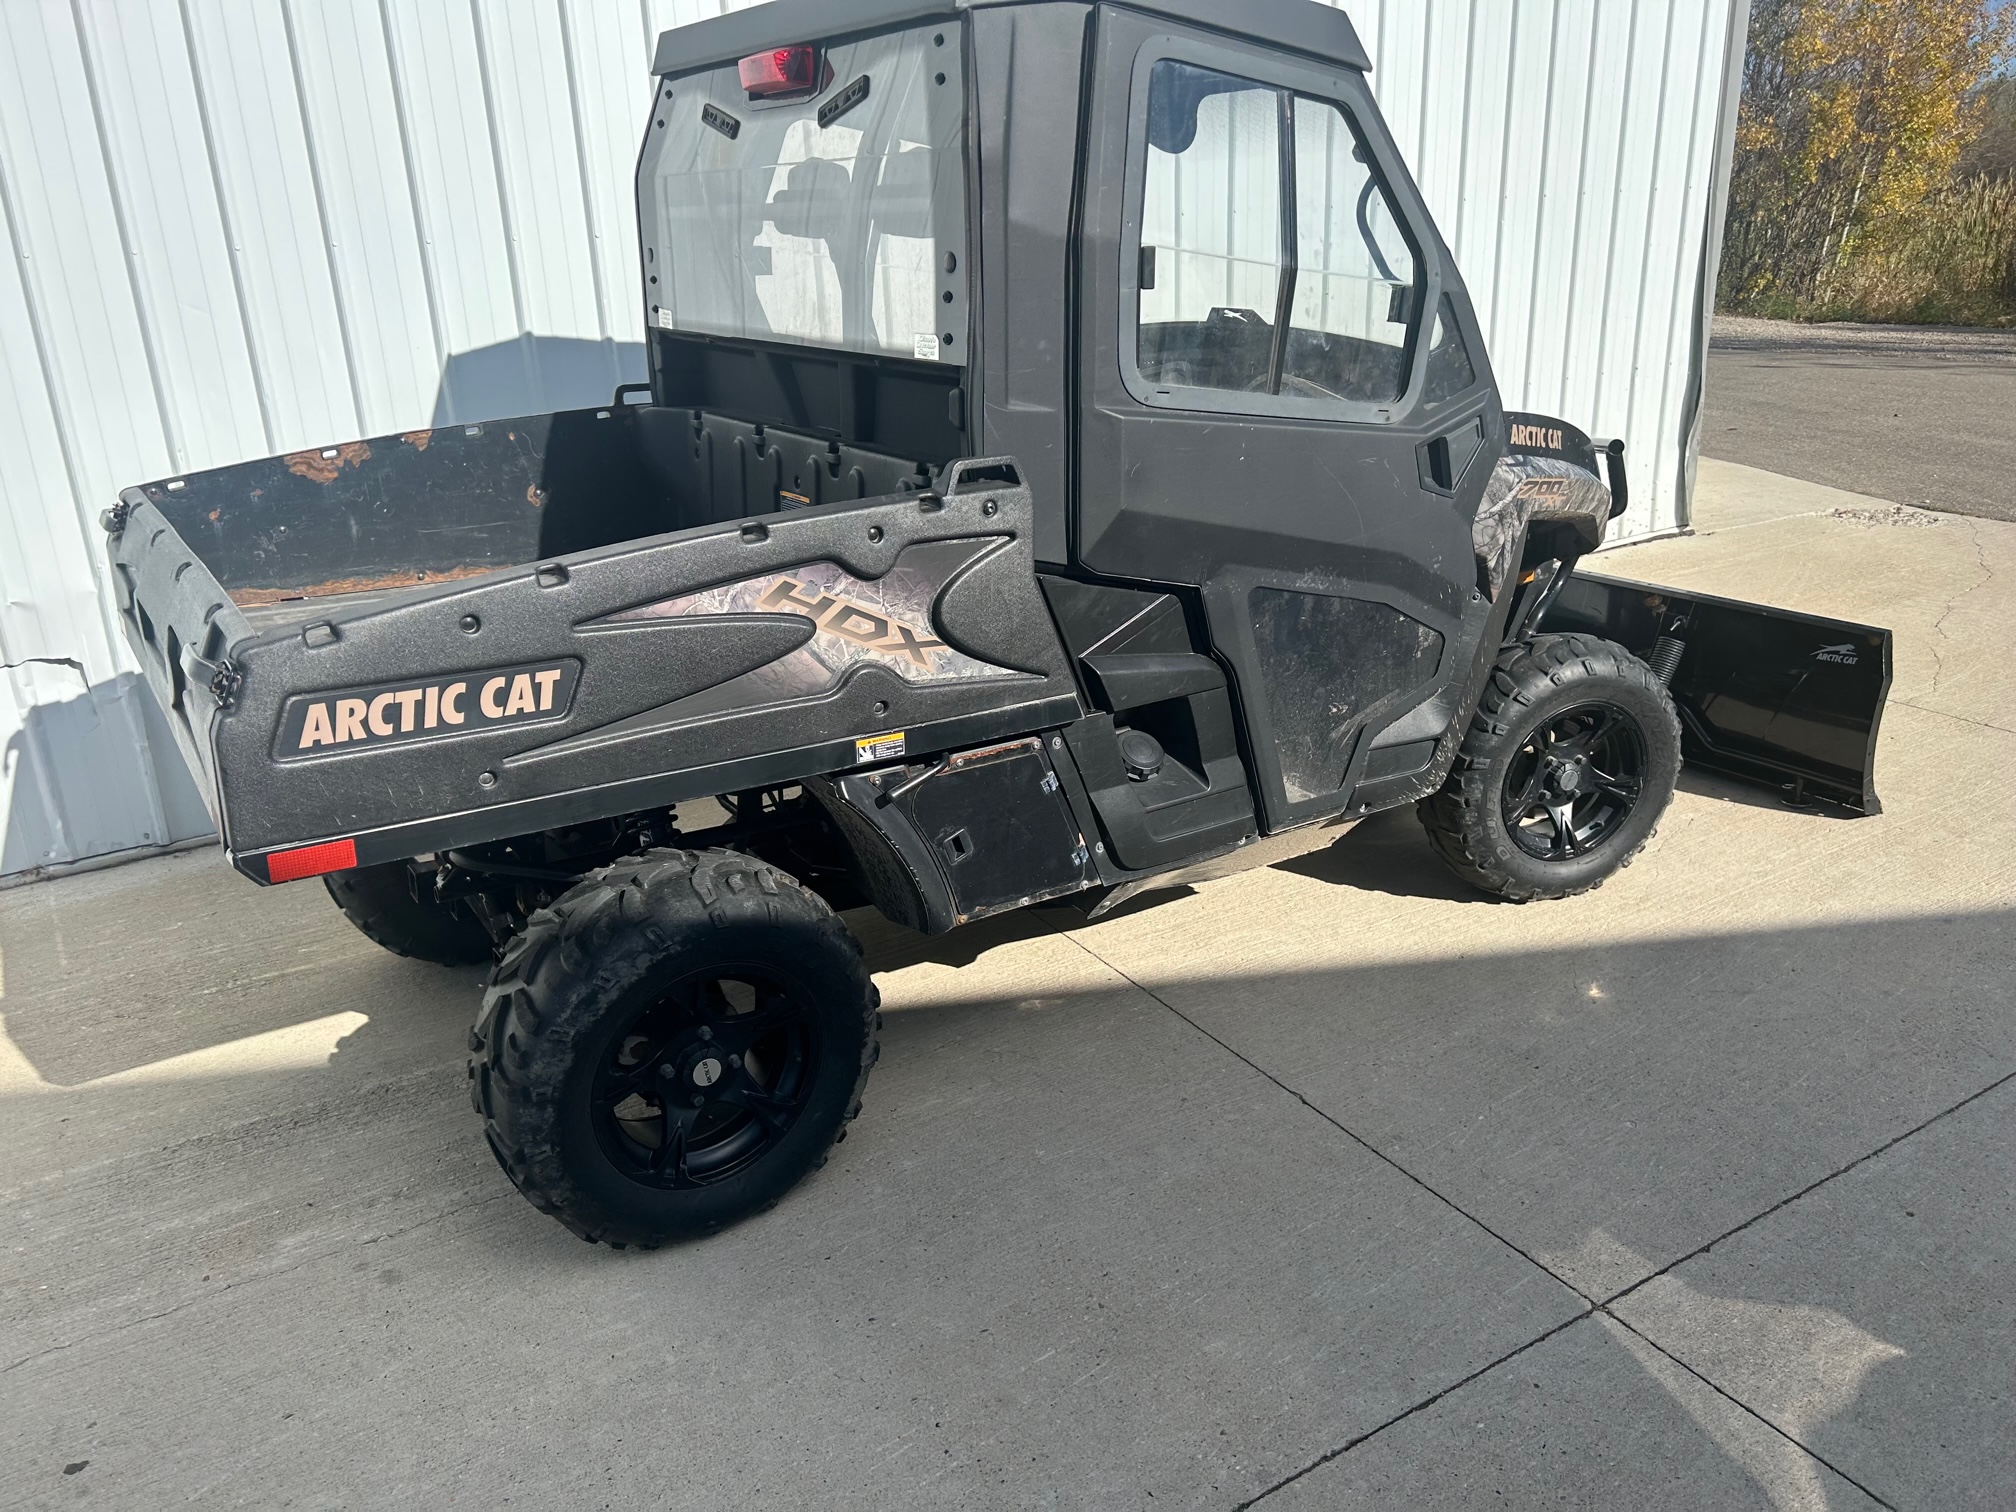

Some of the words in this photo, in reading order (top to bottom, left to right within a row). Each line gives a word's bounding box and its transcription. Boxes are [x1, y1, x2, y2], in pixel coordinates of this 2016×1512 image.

[1510, 424, 1546, 448] ARCTIC
[1548, 428, 1562, 450] CAT
[1517, 477, 1567, 499] 700
[754, 575, 953, 673] HDX
[1816, 652, 1843, 663] ARCTIC
[1843, 656, 1858, 665] CAT
[298, 682, 467, 749] ARCTIC
[479, 669, 561, 719] CAT
[1486, 759, 1512, 861] DURO
